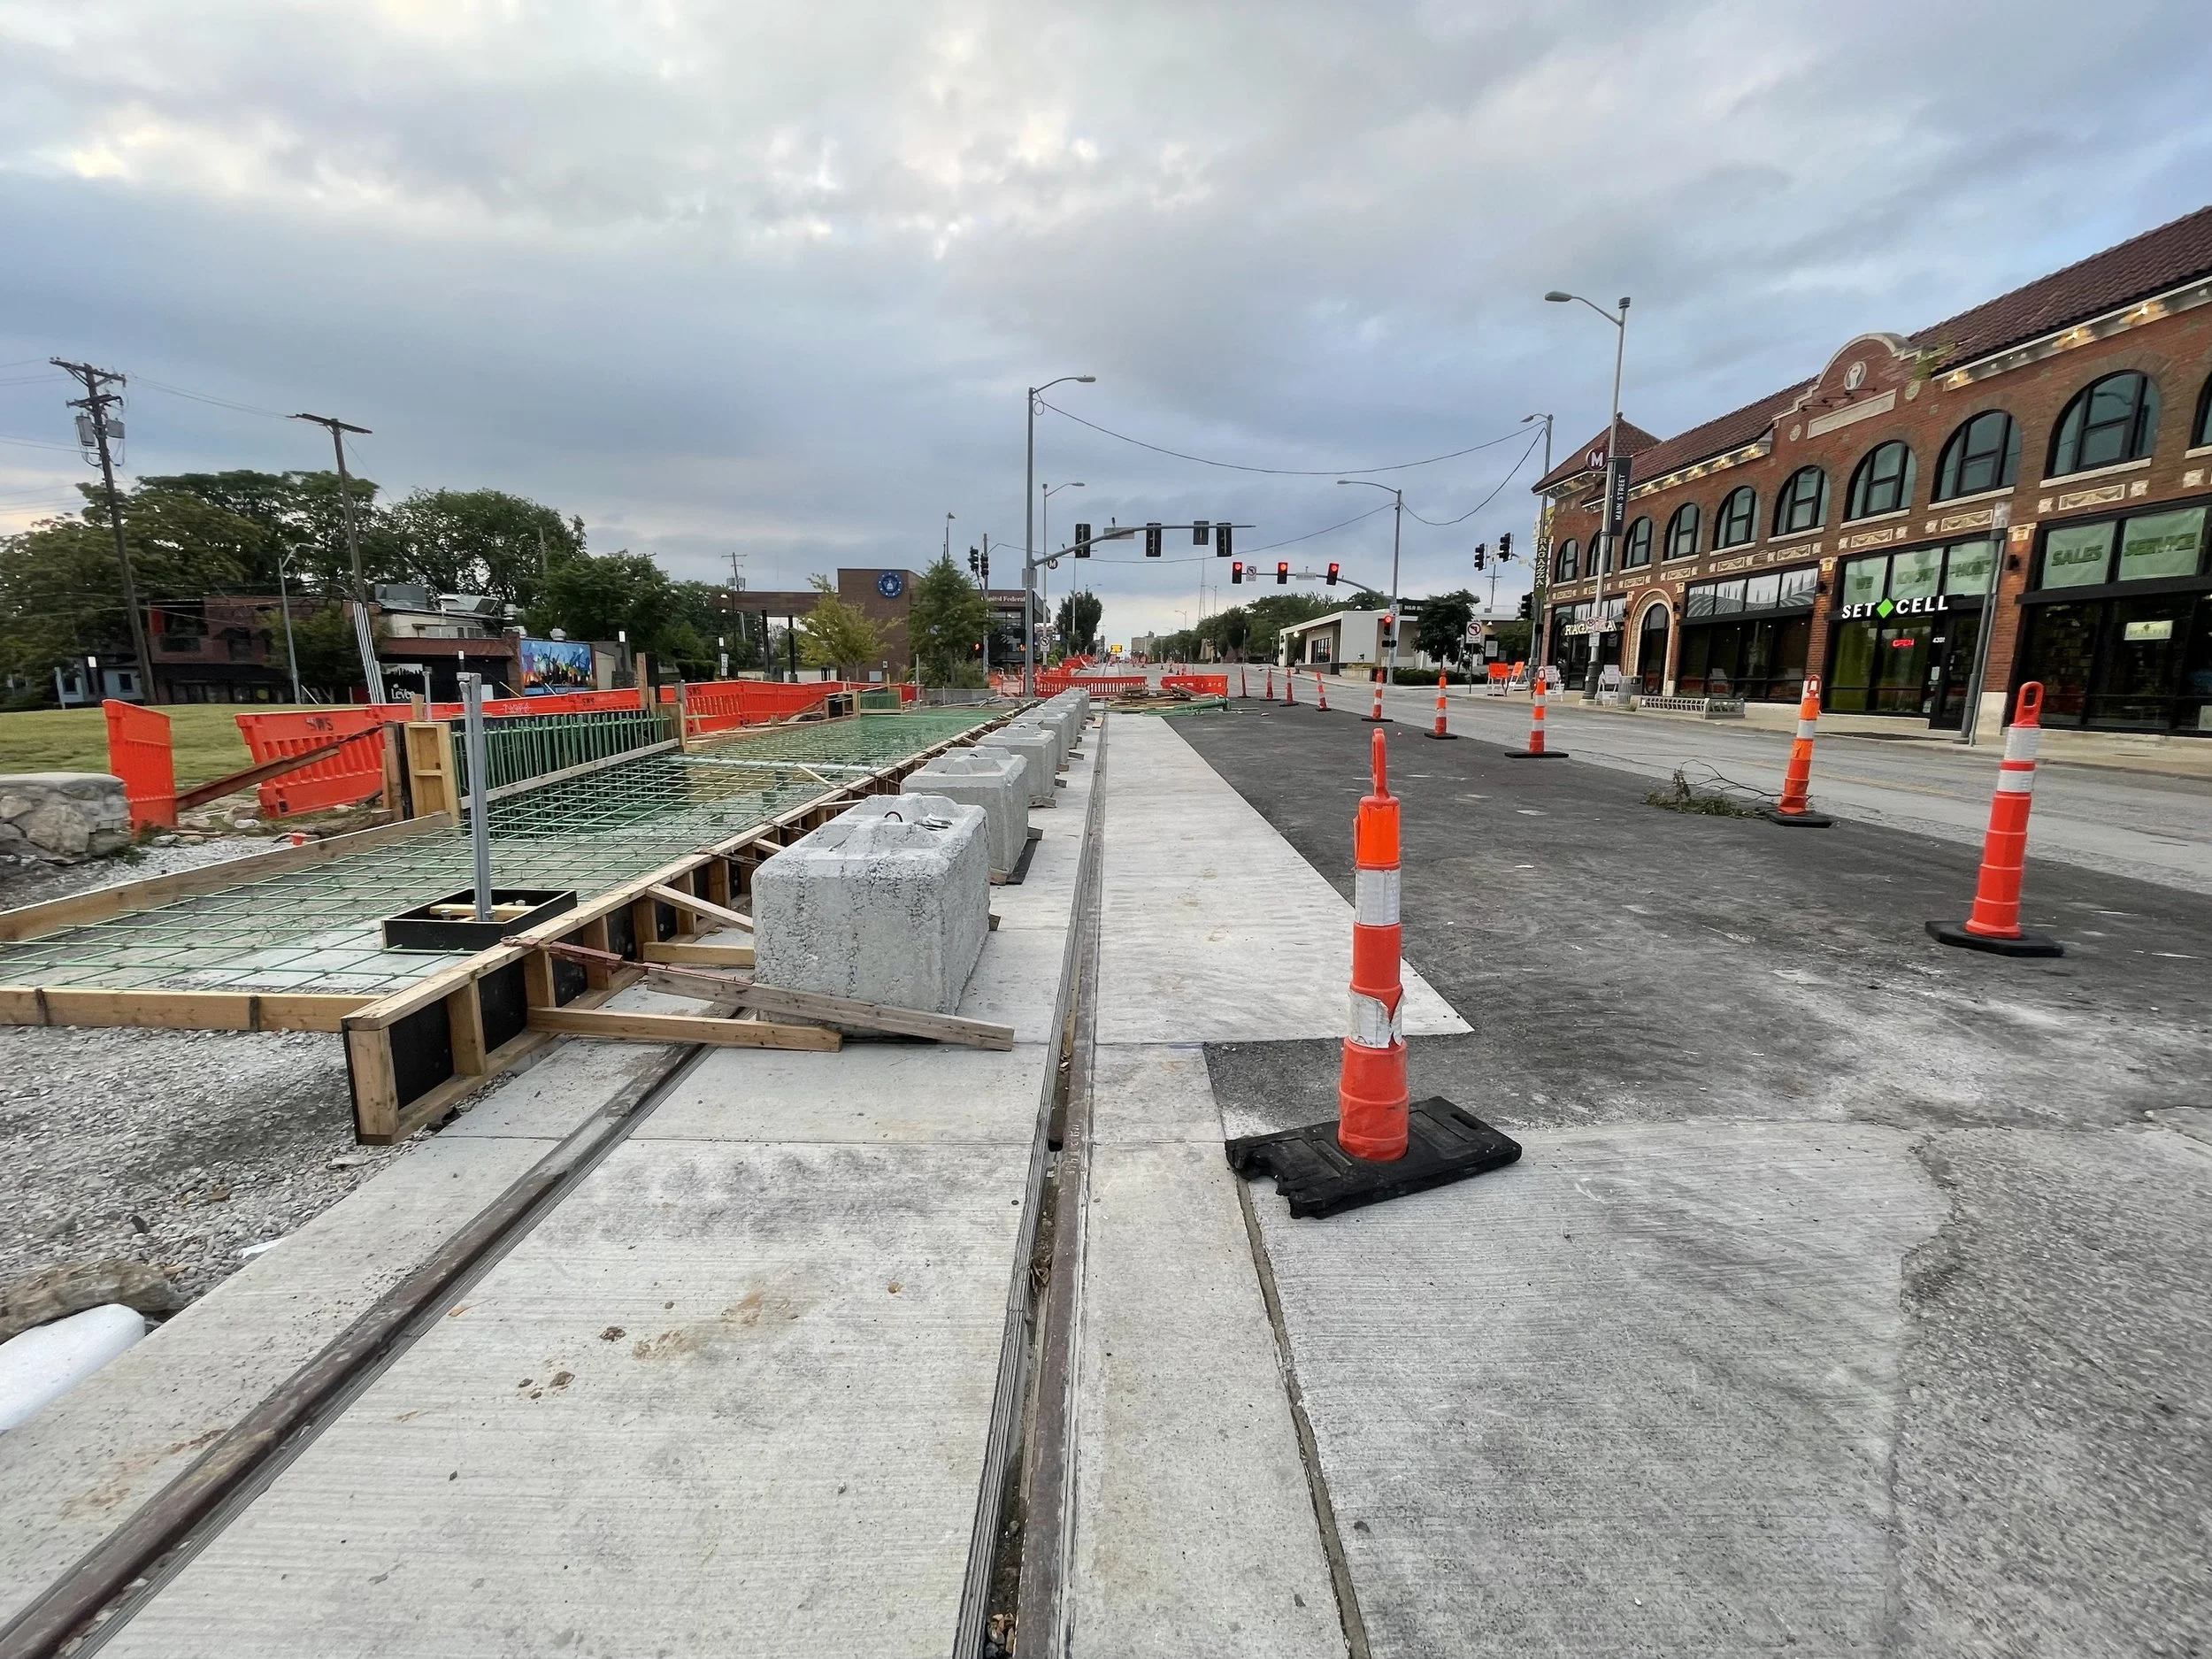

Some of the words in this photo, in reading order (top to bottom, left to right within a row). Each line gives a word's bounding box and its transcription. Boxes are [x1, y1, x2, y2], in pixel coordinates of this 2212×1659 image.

[1617, 474, 1625, 501] STREET
[1615, 503, 1624, 520] MAIN
[1535, 537, 1548, 586] RAGAZZA
[2051, 544, 2103, 567] SALES
[1841, 602, 1876, 619] SET
[1895, 595, 1949, 615] CELL
